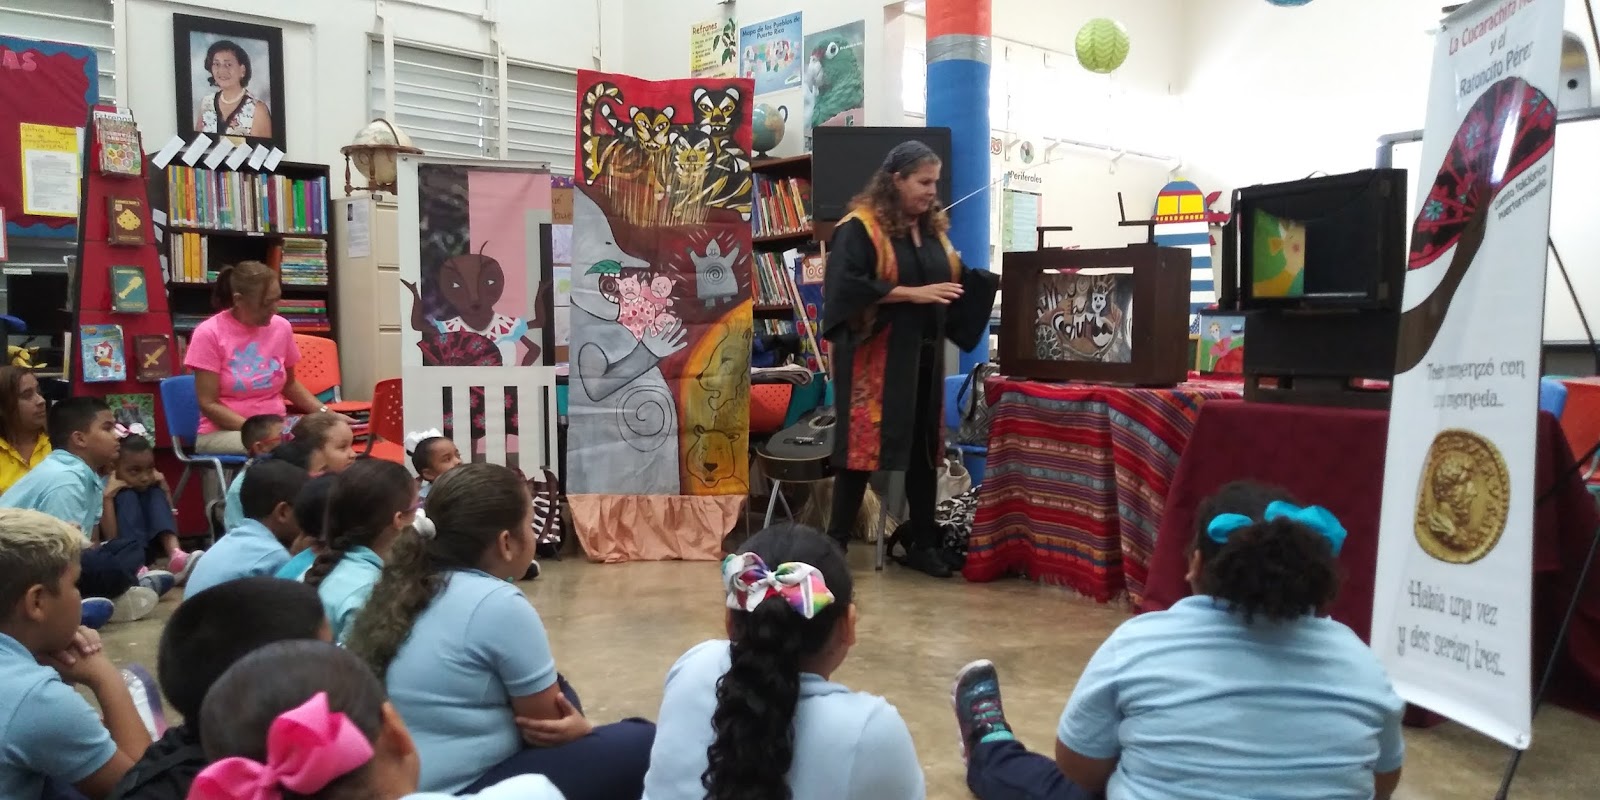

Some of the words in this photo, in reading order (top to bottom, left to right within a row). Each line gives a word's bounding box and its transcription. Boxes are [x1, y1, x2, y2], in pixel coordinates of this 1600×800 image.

[692, 22, 718, 35] Refranes
[742, 29, 756, 37] Mapa
[757, 25, 764, 33] de
[773, 18, 793, 29] Pueblos
[756, 31, 773, 39] Puerto
[1449, 37, 1459, 56] La
[1489, 39, 1497, 56] y
[1460, 60, 1503, 97] Ratoncito
[1500, 360, 1525, 379] con
[1408, 580, 1445, 613] Había
[1449, 595, 1472, 623] una
[1476, 602, 1498, 626] vez
[1397, 626, 1406, 657] y
[1410, 624, 1430, 652] dos
